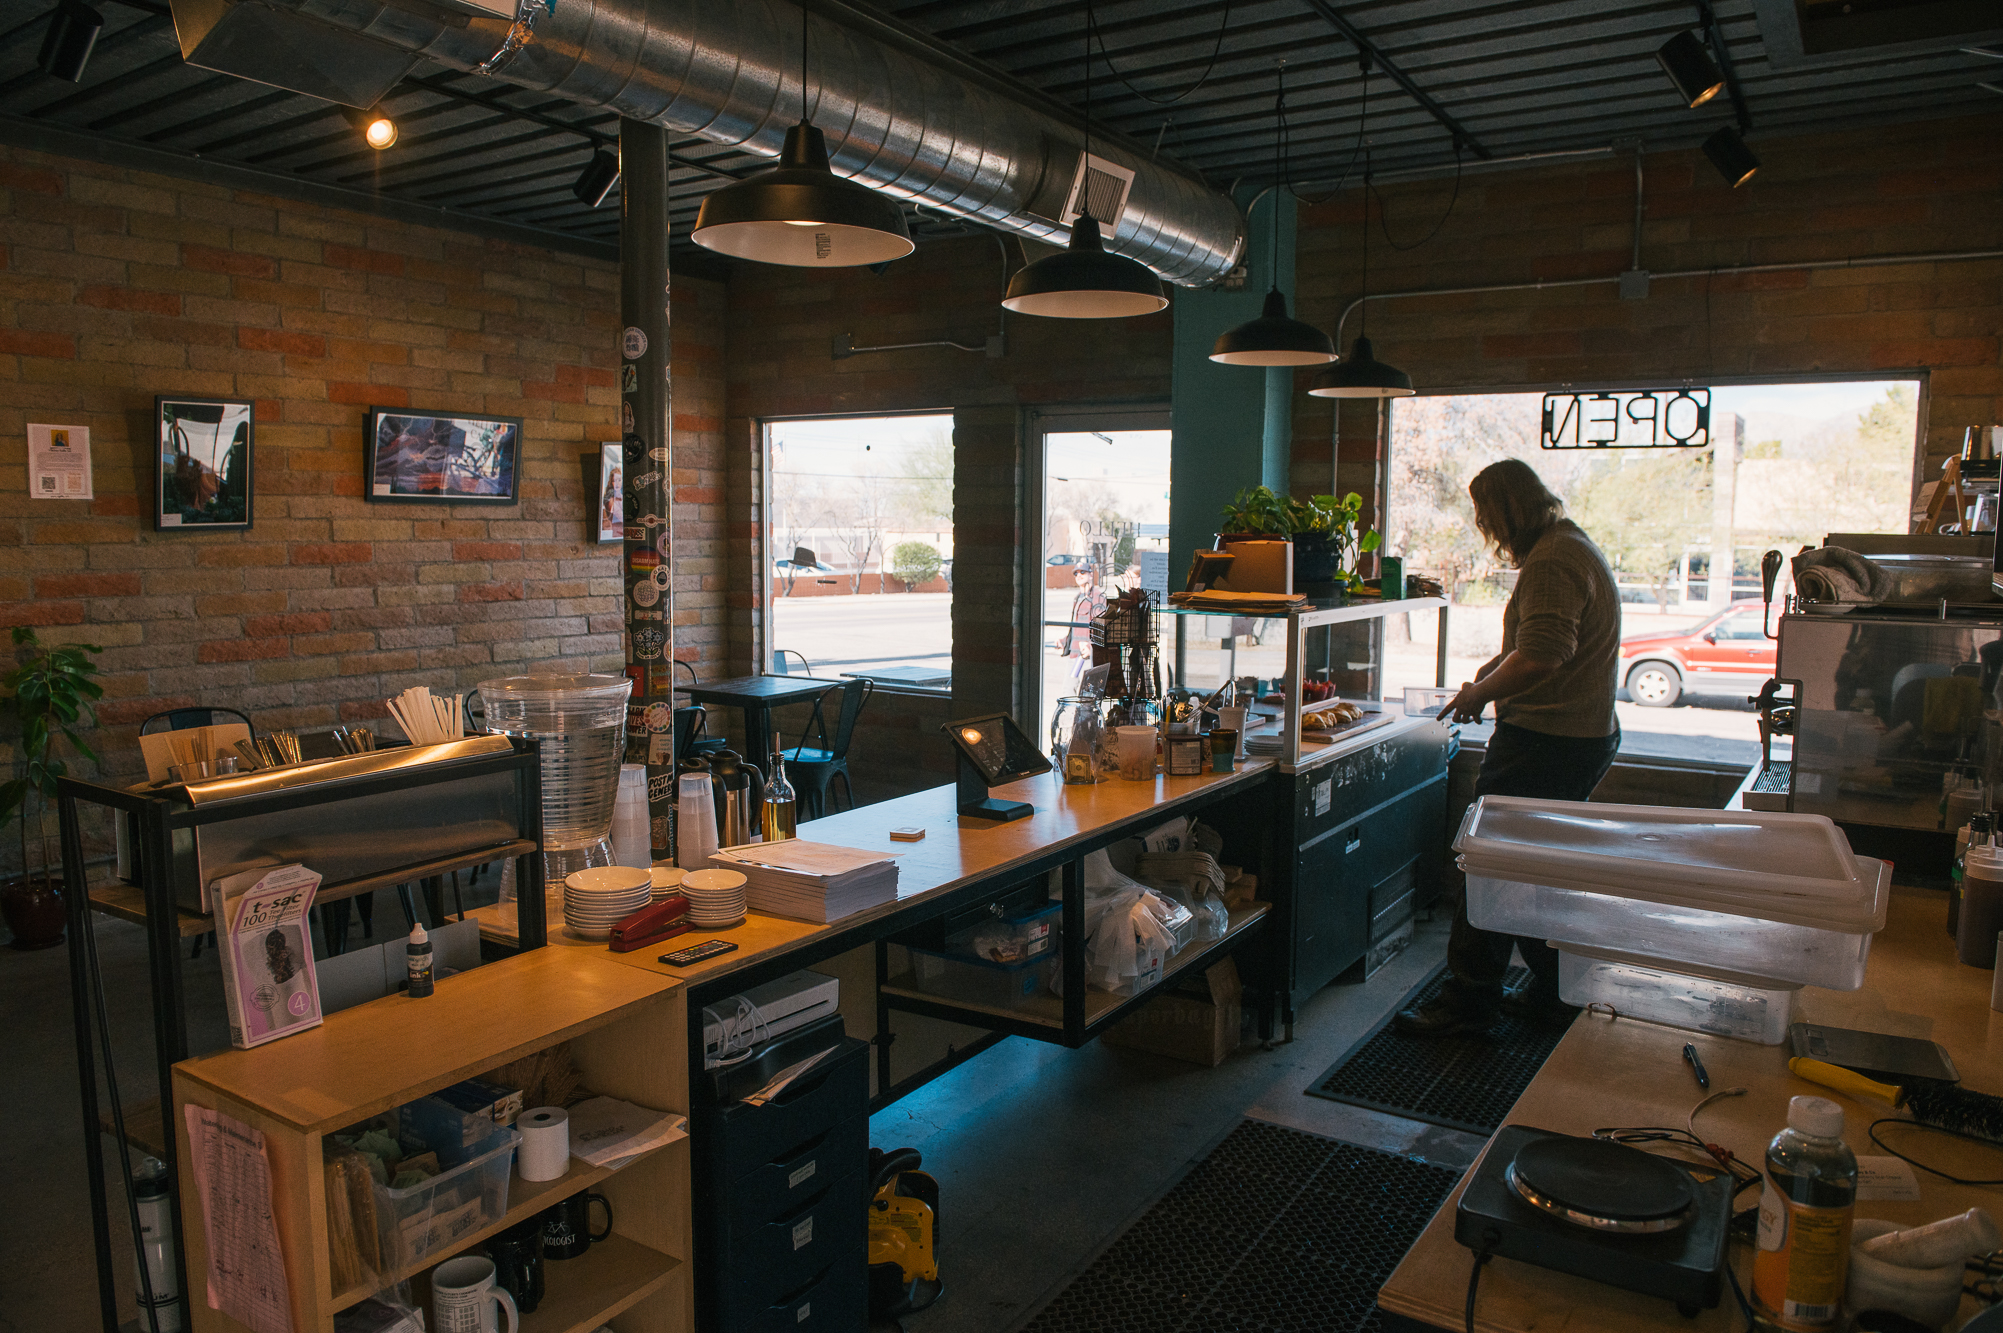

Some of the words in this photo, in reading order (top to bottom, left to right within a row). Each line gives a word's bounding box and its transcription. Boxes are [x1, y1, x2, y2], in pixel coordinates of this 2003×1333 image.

[648, 775, 668, 789] POST
[253, 893, 302, 913] t-sac
[243, 912, 267, 927] 100
[294, 994, 306, 1011] 4
